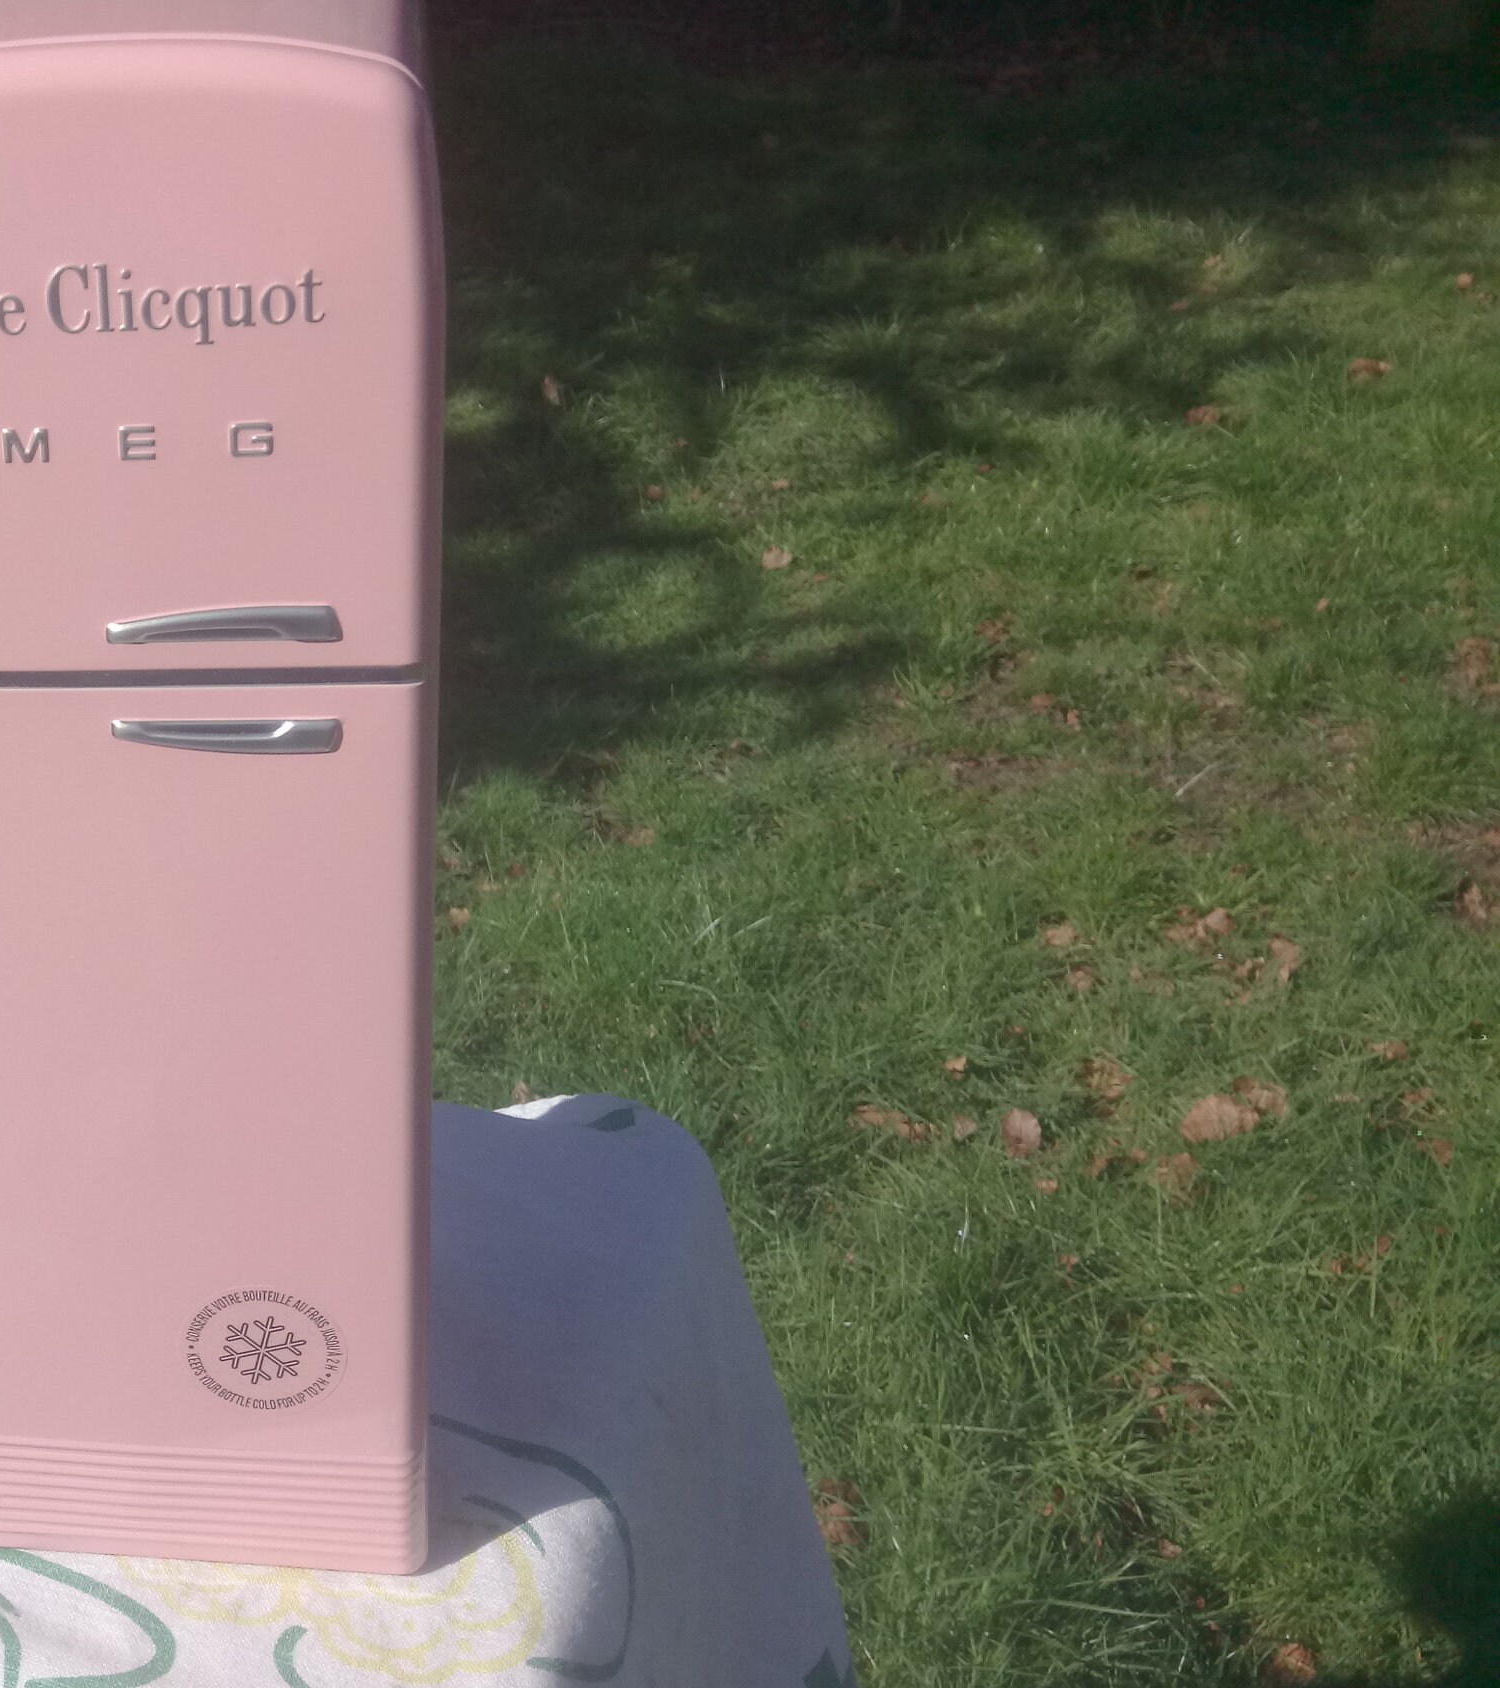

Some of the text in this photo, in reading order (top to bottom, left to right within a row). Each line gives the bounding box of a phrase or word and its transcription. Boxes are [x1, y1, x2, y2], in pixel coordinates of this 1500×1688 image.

[45, 263, 326, 346] Clicquot
[186, 1305, 217, 1342] CONSERVE
[211, 1292, 243, 1311] VOTRE
[242, 1290, 294, 1307] BOUTEILLE
[292, 1299, 308, 1312] AU
[303, 1307, 329, 1328] FRAIS
[187, 1353, 207, 1376] KEEPS
[199, 1373, 222, 1394] YOUR
[217, 1388, 252, 1408] BOTTLE
[252, 1399, 277, 1410] COLD
[277, 1396, 296, 1409] FOR
[293, 1392, 307, 1404] UP
[303, 1386, 319, 1398] TO
